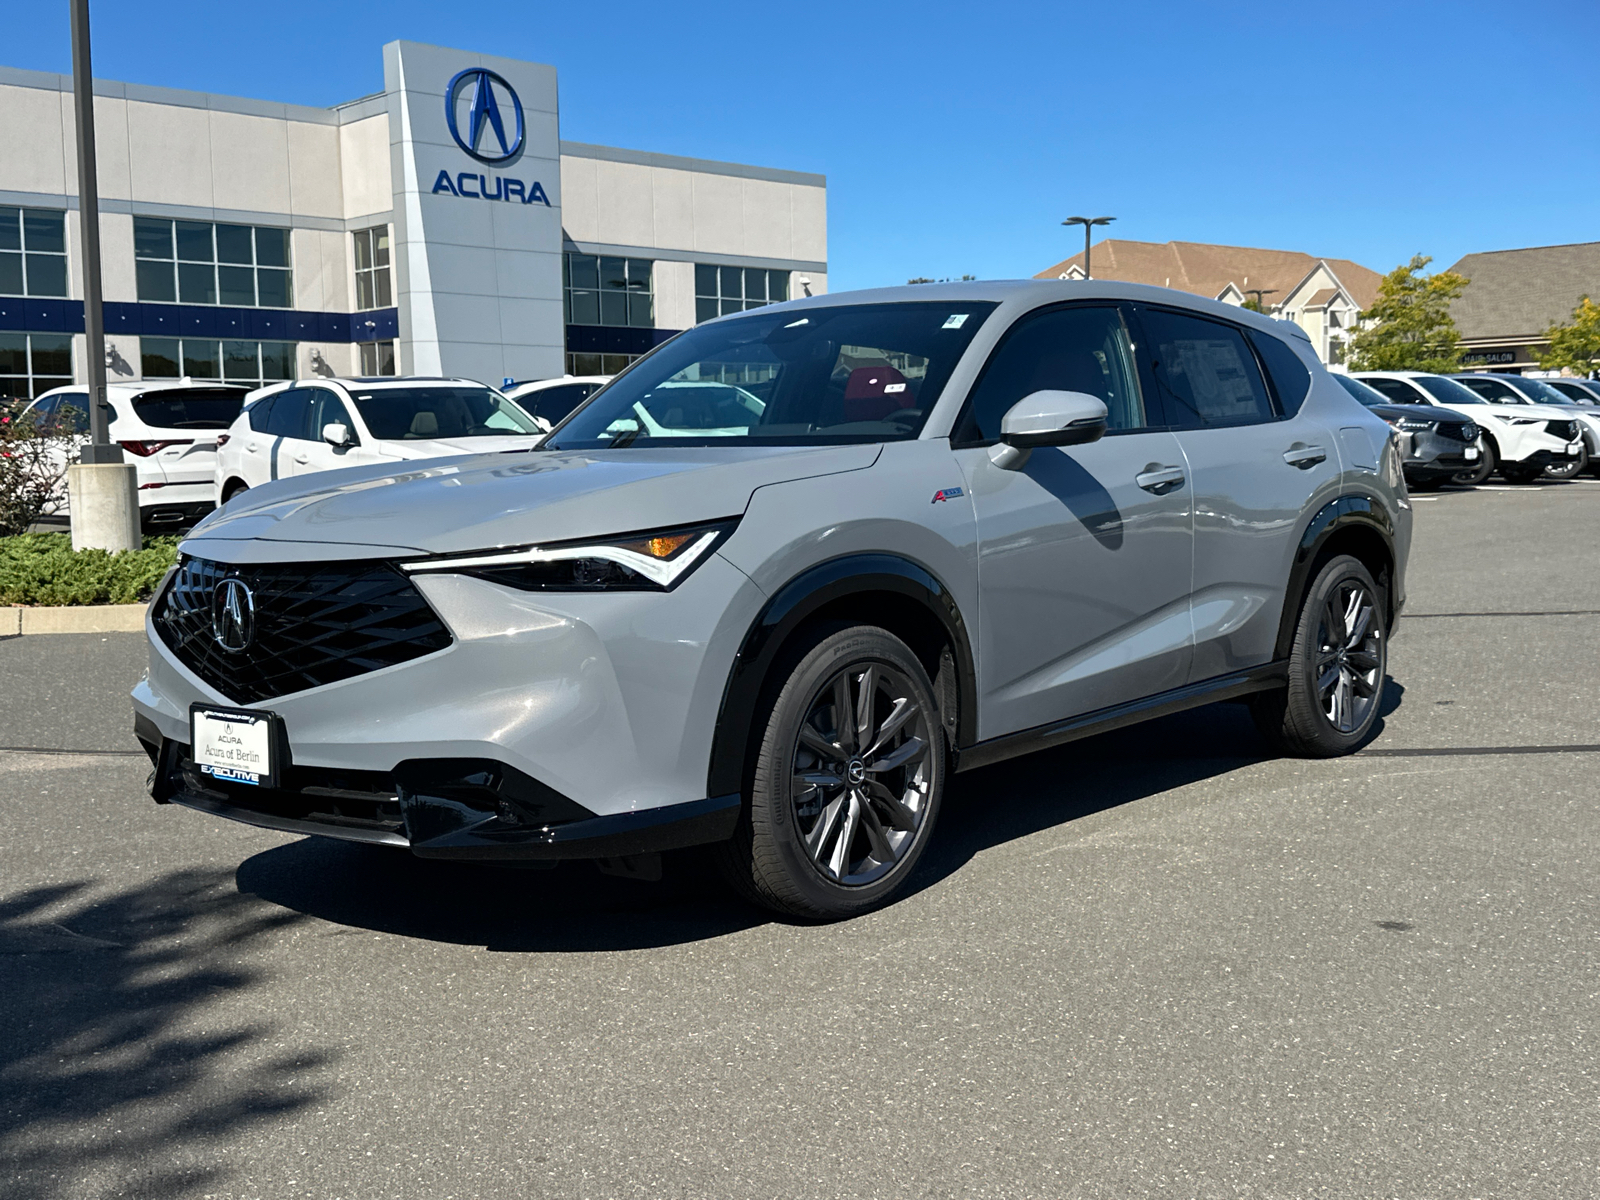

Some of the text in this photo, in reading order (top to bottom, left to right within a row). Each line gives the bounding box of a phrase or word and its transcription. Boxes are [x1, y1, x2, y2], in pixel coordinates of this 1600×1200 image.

[432, 170, 552, 208] ACURA
[1486, 352, 1513, 363] SALON
[218, 736, 242, 745] ACURA
[205, 745, 260, 763] Acura of Berlin
[201, 764, 259, 782] EXECUTIVE
[771, 756, 785, 826] Continental
